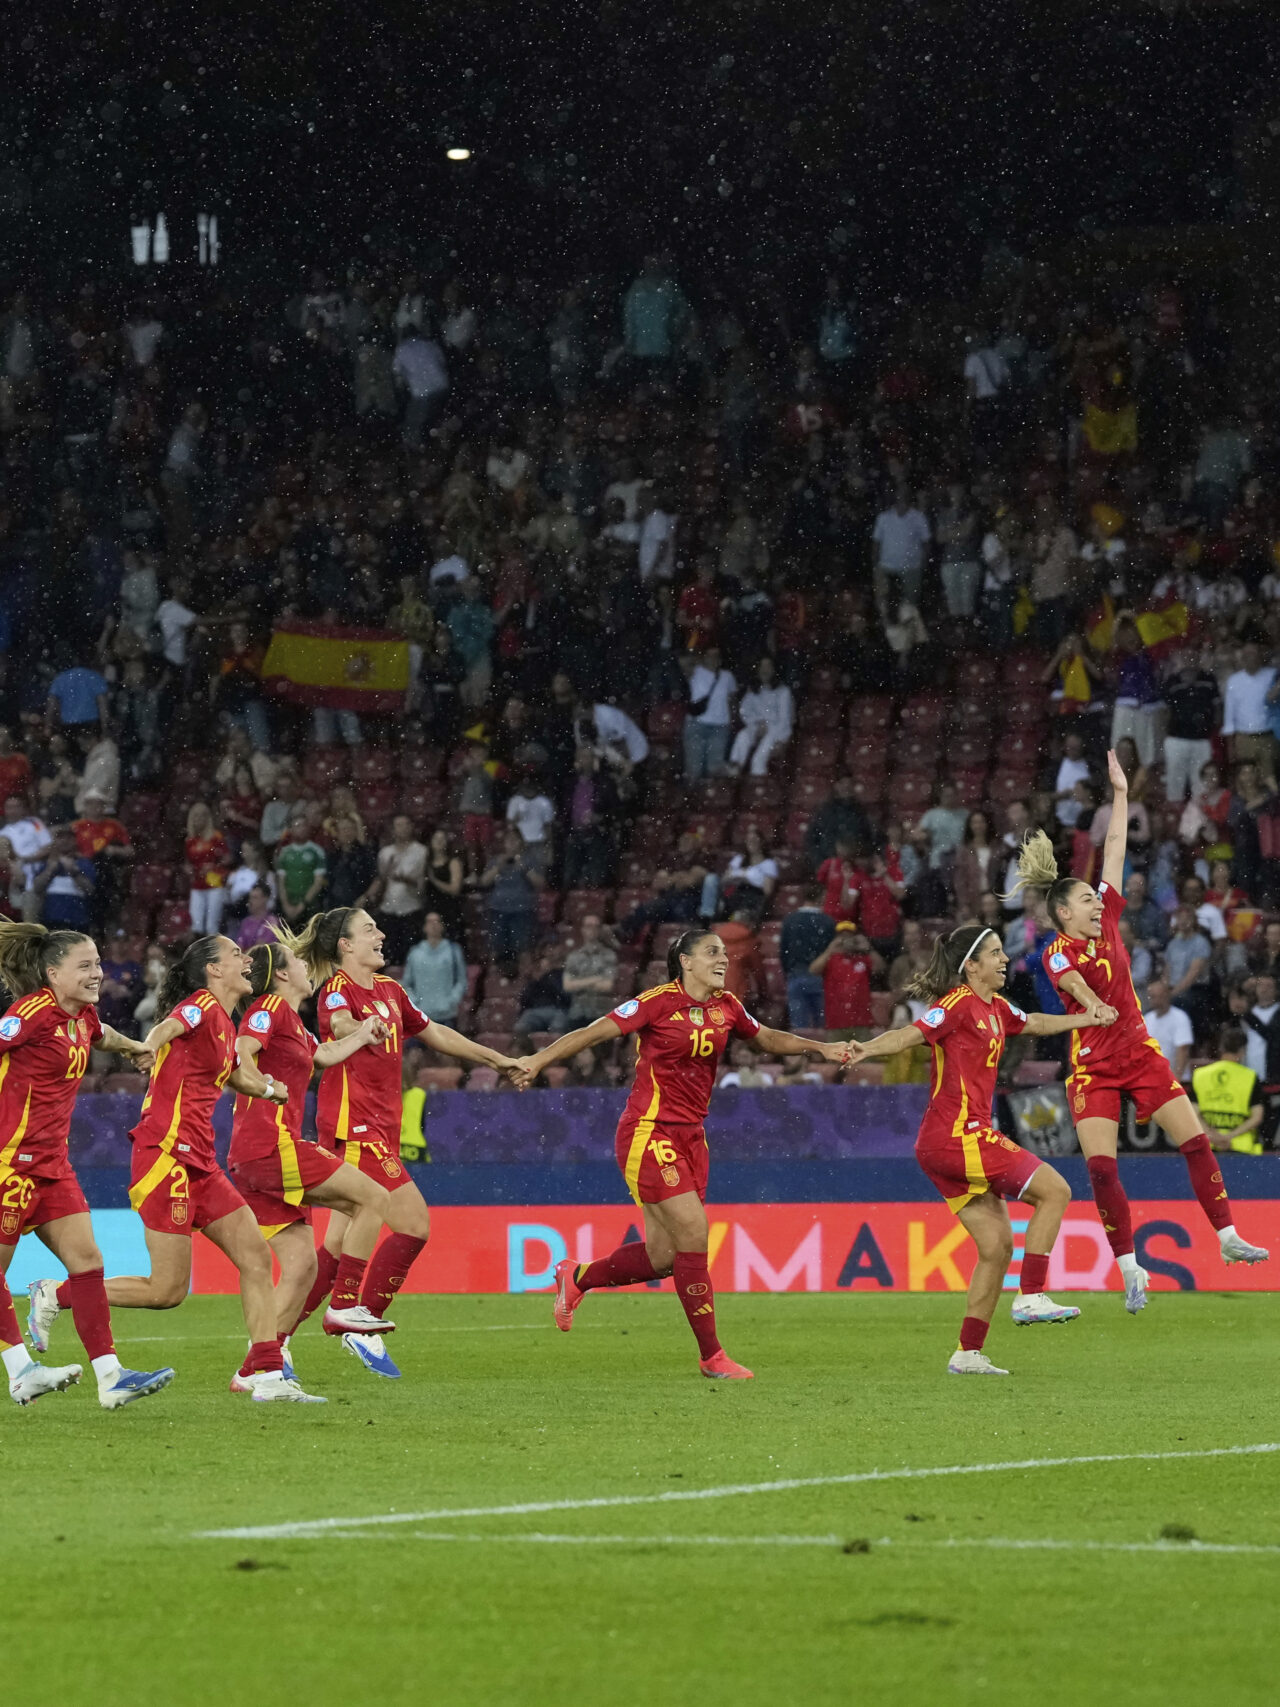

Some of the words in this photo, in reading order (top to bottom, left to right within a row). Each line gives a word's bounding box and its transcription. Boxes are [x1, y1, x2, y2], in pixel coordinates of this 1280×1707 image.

[1096, 958, 1112, 982] 7
[690, 1029, 714, 1057] 16
[65, 1046, 87, 1079] 20
[647, 1140, 677, 1167] 16
[1, 1175, 35, 1210] 20
